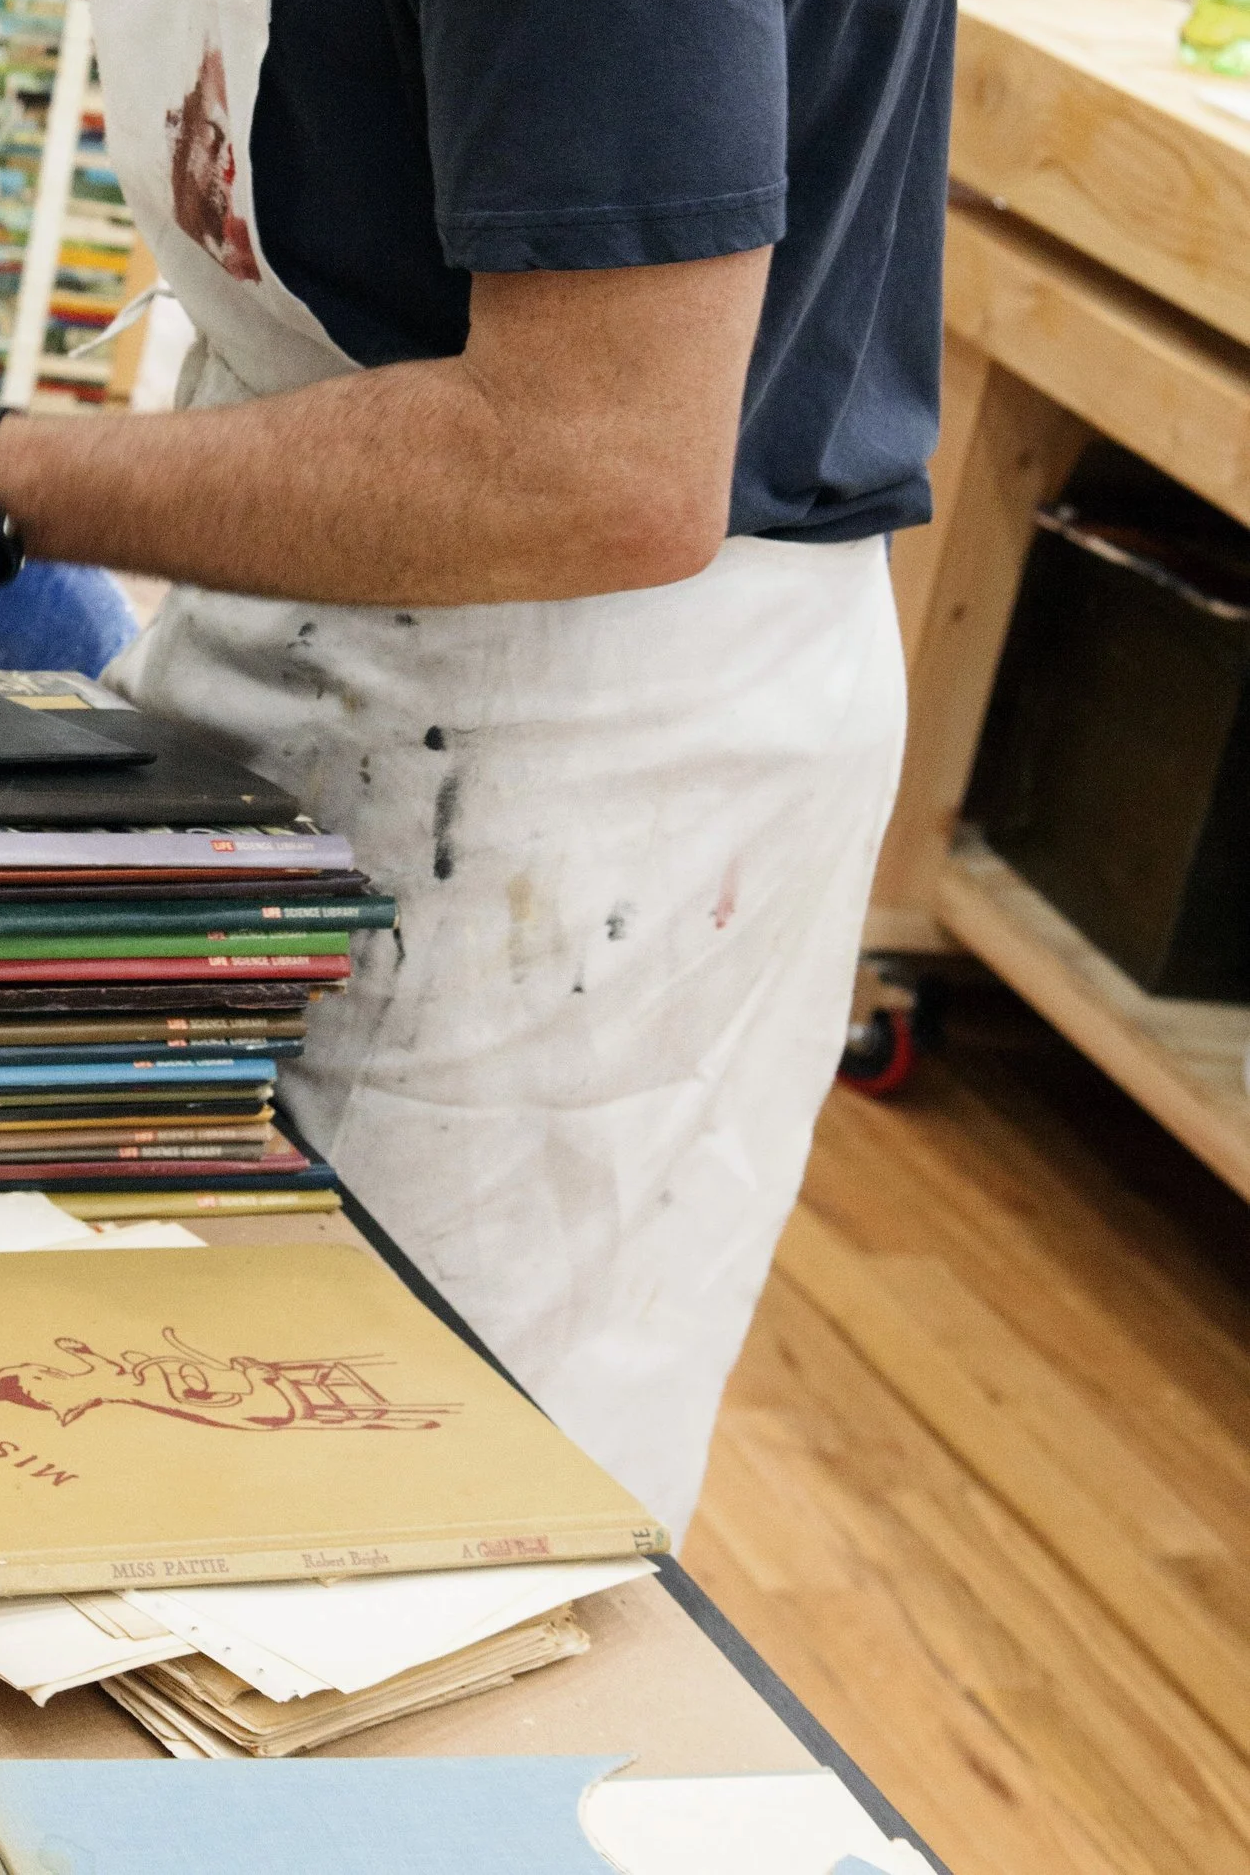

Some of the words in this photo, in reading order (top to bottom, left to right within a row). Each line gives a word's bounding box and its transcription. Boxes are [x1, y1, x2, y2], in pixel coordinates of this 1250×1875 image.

[261, 907, 283, 919] LIFE
[284, 907, 320, 918] SCIENCE
[322, 907, 360, 918] LIBRARY
[110, 1562, 156, 1580] MISS
[164, 1557, 230, 1577] PATTIE
